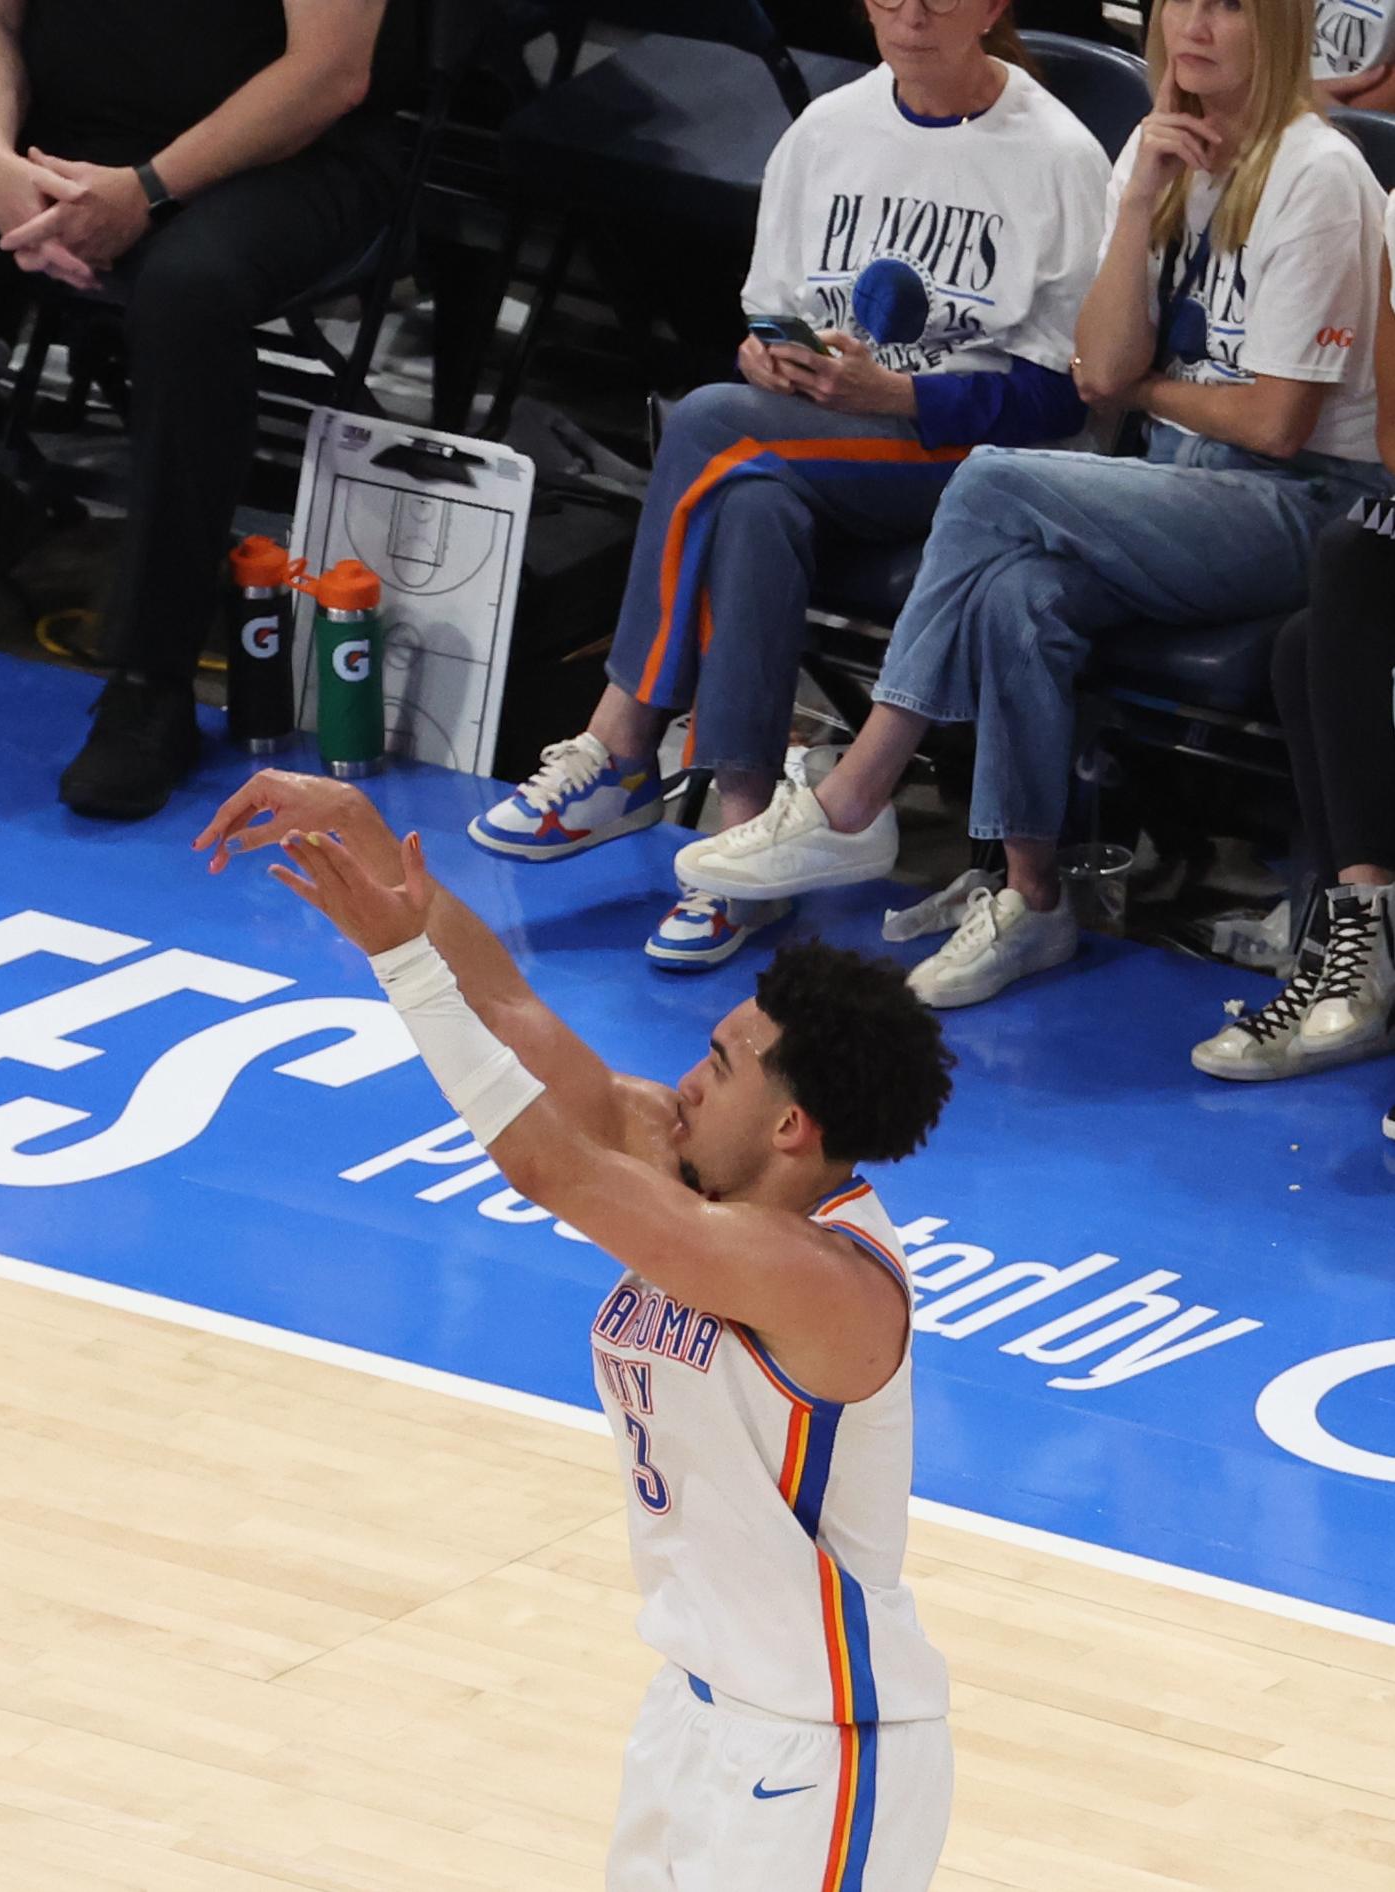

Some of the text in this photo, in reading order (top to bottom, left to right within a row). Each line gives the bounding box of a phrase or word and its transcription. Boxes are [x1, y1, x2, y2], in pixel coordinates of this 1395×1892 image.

[1316, 326, 1354, 347] OG
[241, 616, 279, 659] G
[332, 639, 371, 682] G
[997, 1269, 1264, 1390] by
[622, 1411, 672, 1517] 3
